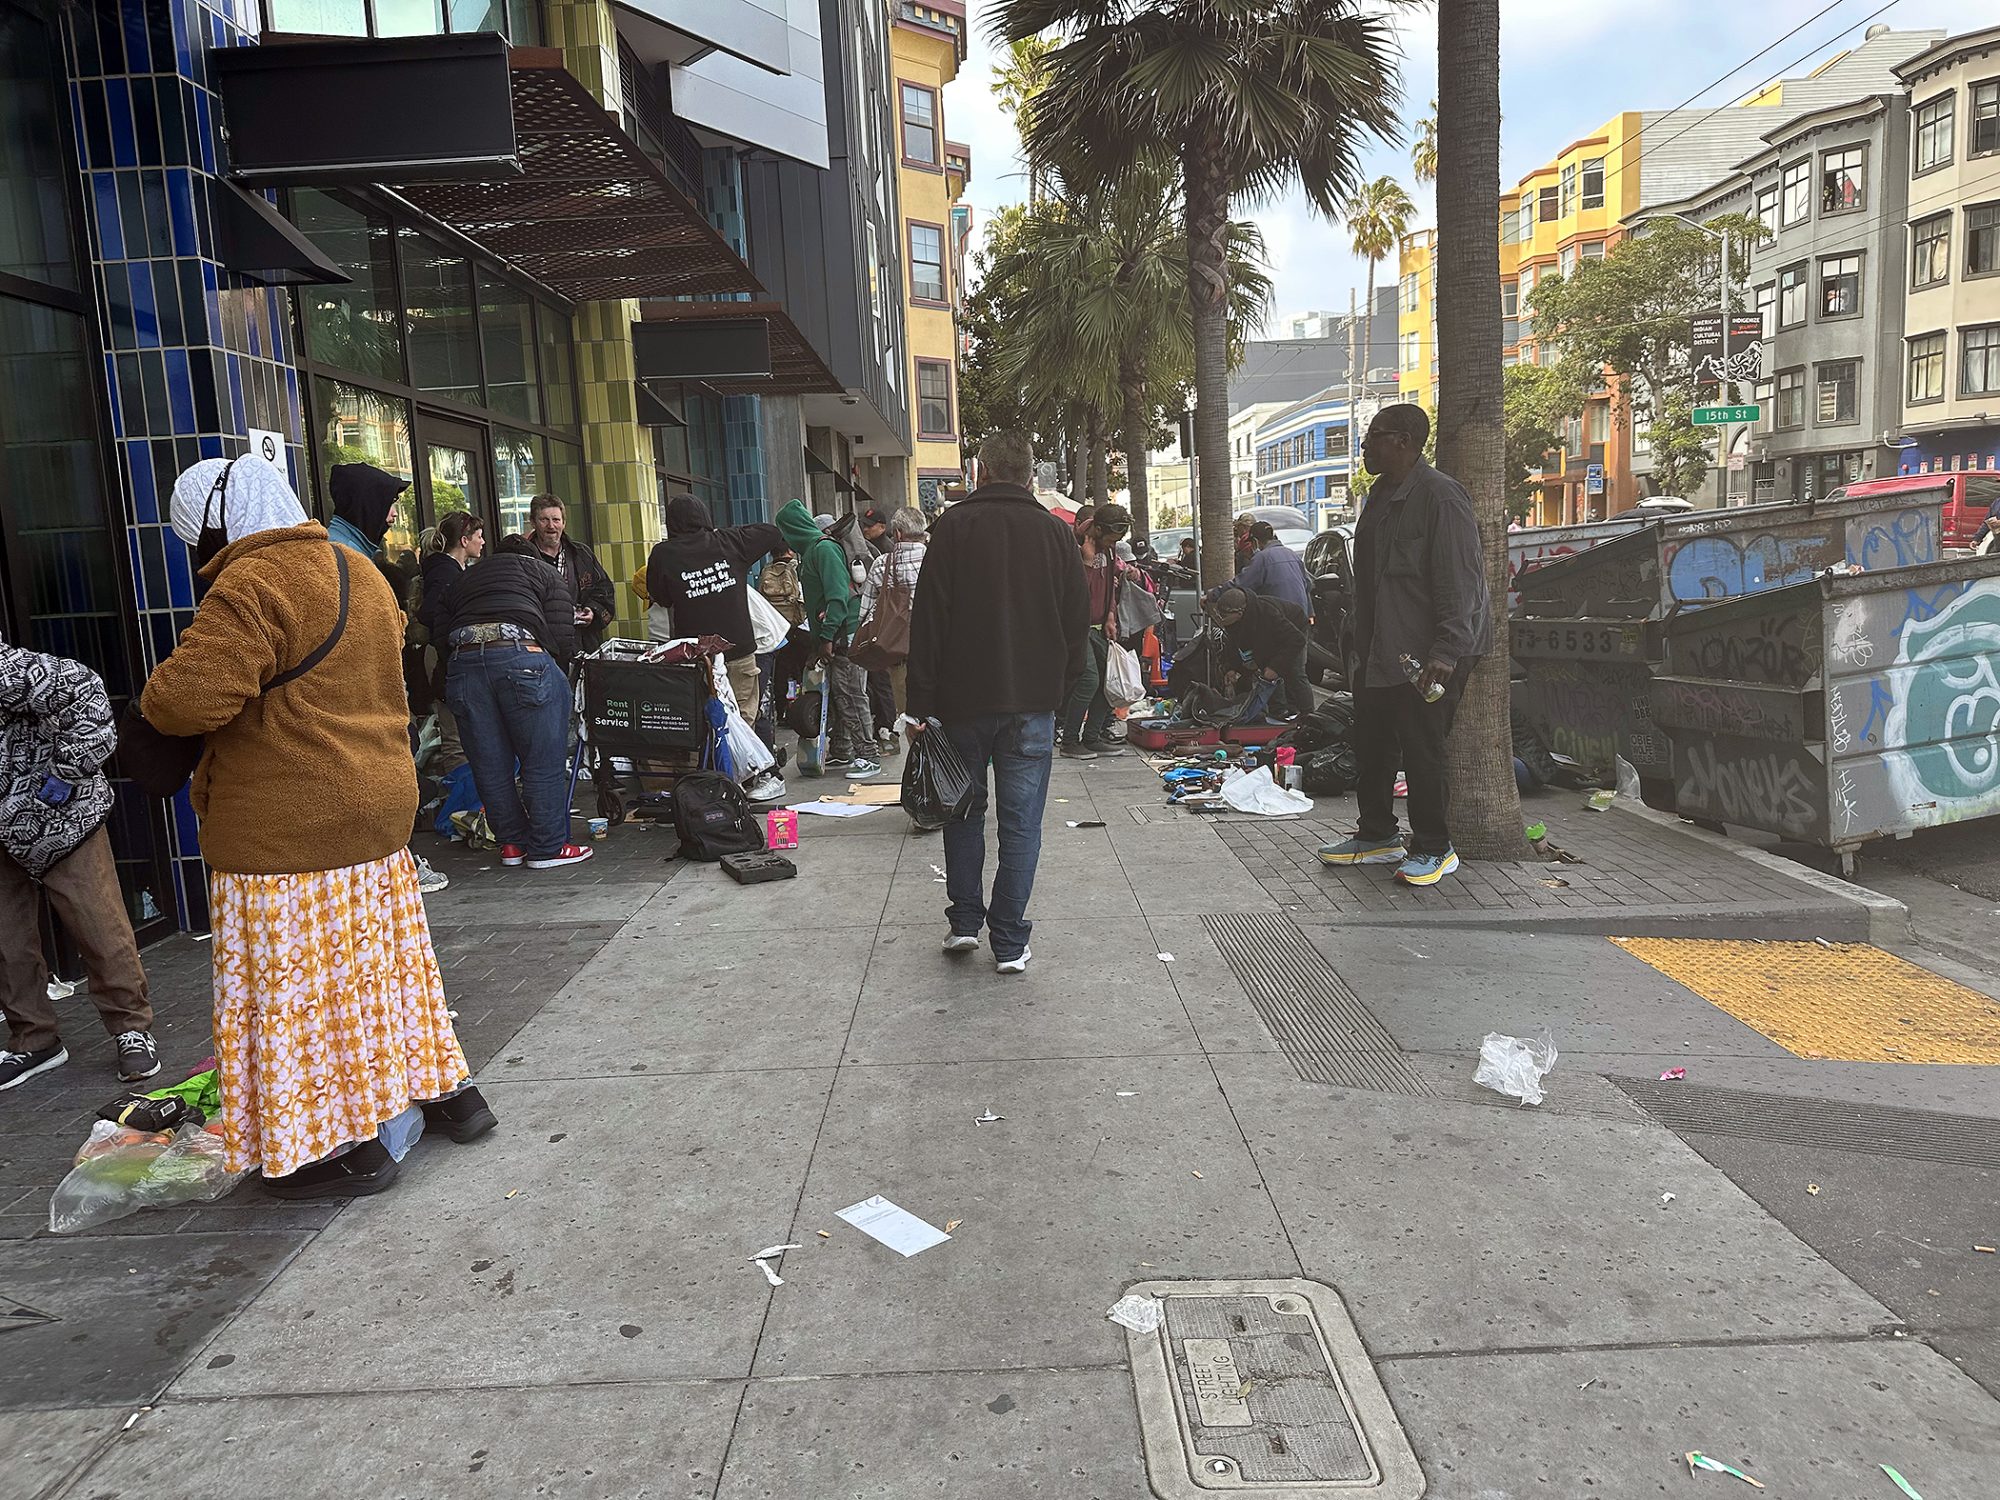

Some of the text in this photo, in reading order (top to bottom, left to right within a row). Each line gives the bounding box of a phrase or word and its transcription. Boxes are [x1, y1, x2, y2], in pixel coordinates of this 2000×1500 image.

[1692, 318, 1721, 326] AMERICAN
[1692, 325, 1713, 333] INDIAN
[1693, 331, 1722, 339] CULTURAL
[1693, 338, 1719, 346] DISTRICT
[1705, 409, 1747, 421] 15th St
[681, 570, 703, 581] Born
[689, 575, 717, 589] Driven
[685, 577, 737, 599] Talus Agents
[606, 699, 629, 709] Rent
[607, 708, 629, 718] Own
[594, 716, 630, 728] Service
[1193, 1362, 1218, 1399] STREET
[1213, 1355, 1242, 1406] LIGHTING
